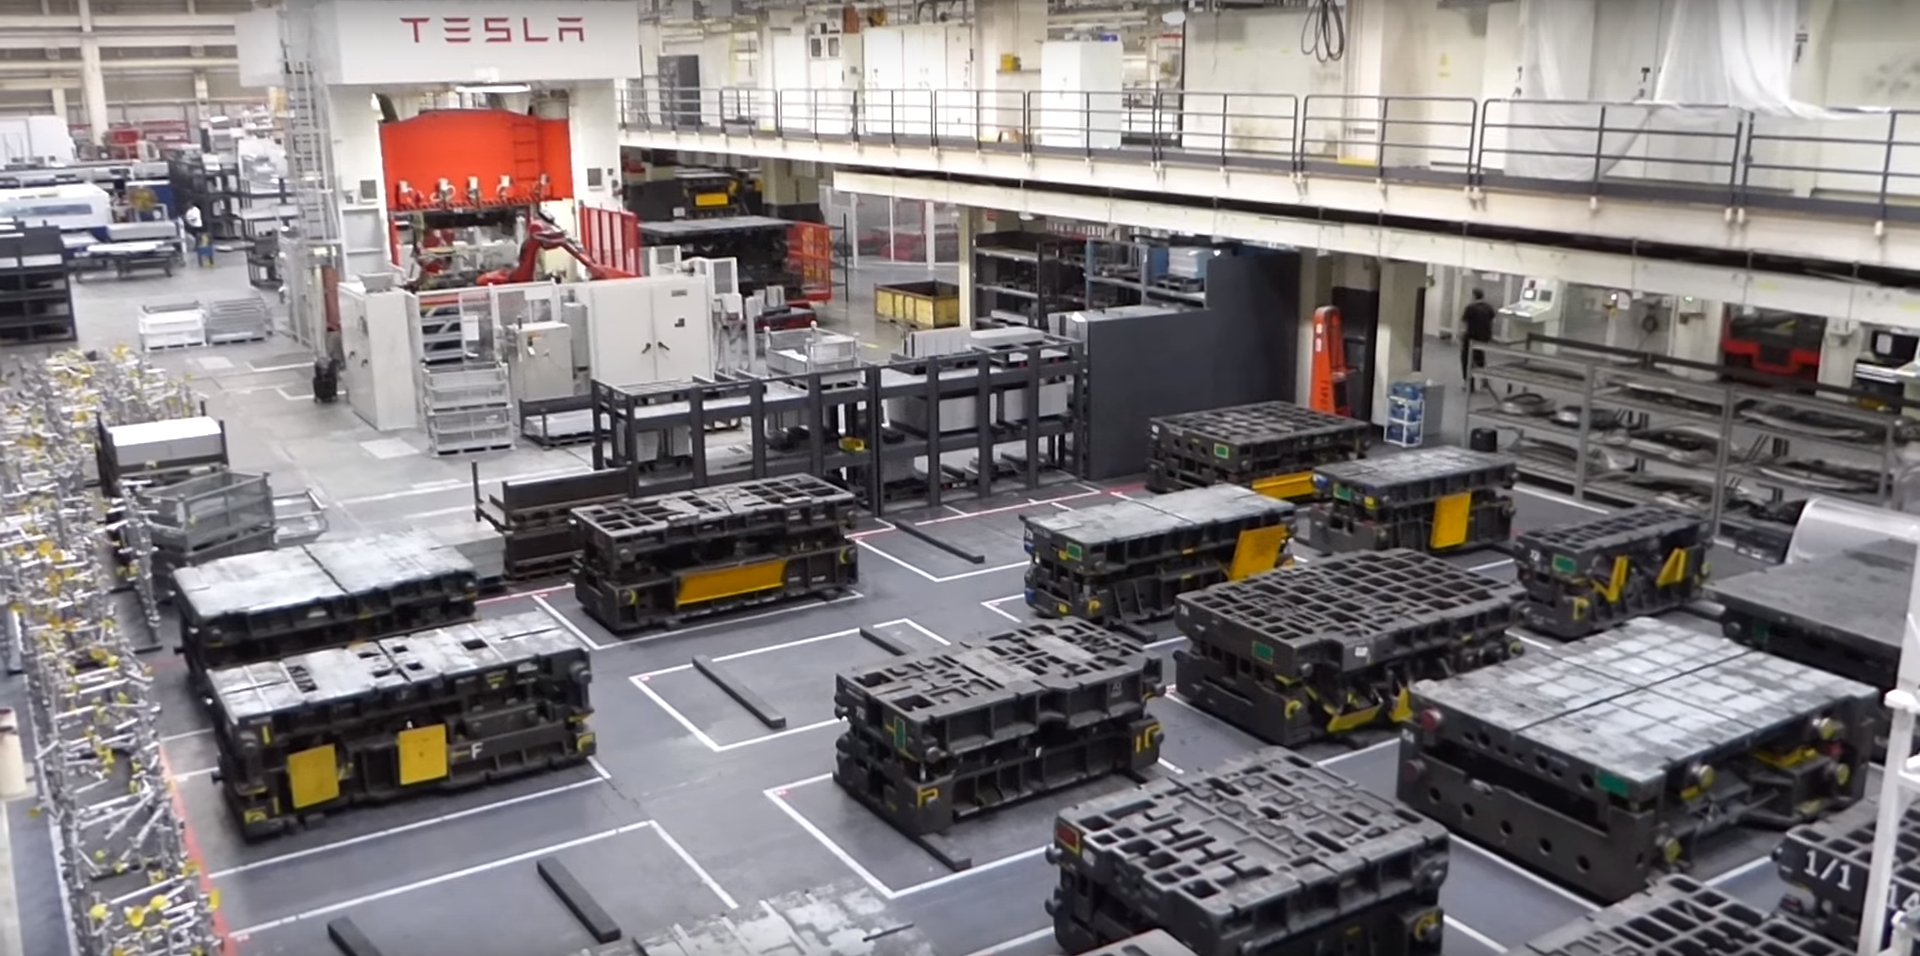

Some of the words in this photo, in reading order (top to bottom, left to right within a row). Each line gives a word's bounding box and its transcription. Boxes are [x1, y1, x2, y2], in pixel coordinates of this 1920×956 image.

[399, 16, 585, 43] TESLA
[471, 741, 483, 759] F
[1803, 850, 1851, 890] 1/1
